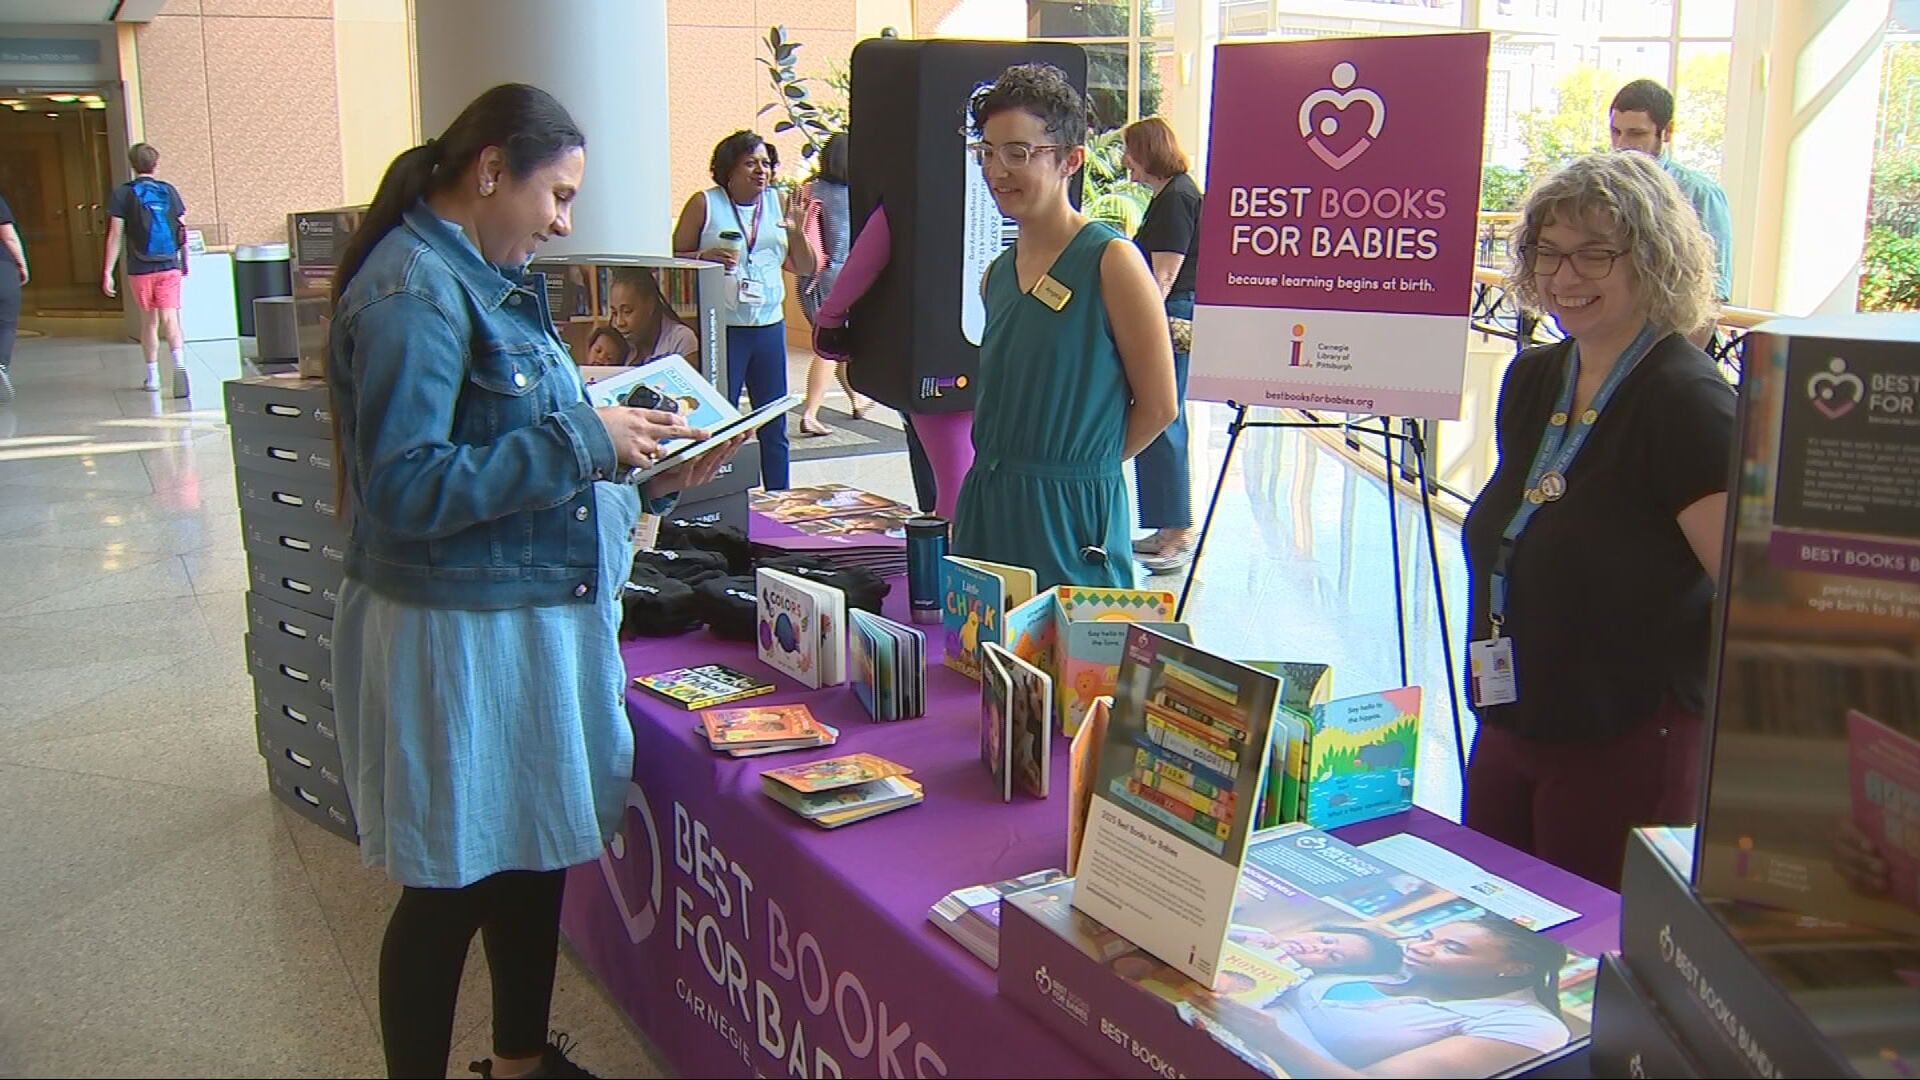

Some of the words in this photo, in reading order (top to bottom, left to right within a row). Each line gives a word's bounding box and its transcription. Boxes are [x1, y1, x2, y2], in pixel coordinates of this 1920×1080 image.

[1229, 188, 1312, 218] BEST
[1319, 188, 1447, 219] BOOKS
[1231, 225, 1301, 256] FOR
[1311, 227, 1438, 260] BABIES
[1228, 272, 1278, 287] because
[1281, 275, 1334, 292] learning
[1337, 276, 1379, 292] begins
[1382, 279, 1397, 291] at
[1399, 277, 1436, 293] birth.
[1317, 352, 1341, 362] Library
[1342, 353, 1351, 361] of
[1318, 343, 1349, 352] Carnegie
[1316, 362, 1353, 371] Pittsburgh
[1871, 374, 1920, 394] BEST
[1265, 390, 1375, 408] bestbooksforbabies.org
[1869, 394, 1913, 413] FOR
[1801, 546, 1840, 563] BEST
[1845, 551, 1906, 571] BOOKS
[962, 580, 980, 596] Little
[1822, 583, 1871, 598] perfect
[1875, 585, 1894, 600] for
[770, 591, 801, 618] COLORS
[946, 592, 996, 632] CHICK
[1808, 597, 1834, 613] age
[1837, 597, 1869, 613] birth
[1873, 600, 1887, 614] to
[1088, 630, 1100, 638] Say
[1348, 706, 1359, 714] Say
[1360, 703, 1375, 711] hello
[674, 800, 753, 941] BEST
[675, 886, 751, 1023] FOR
[1675, 947, 1699, 988] BEST
[1700, 976, 1738, 1038] BOOKS
[676, 977, 751, 1067] CARNEGIE
[1100, 1017, 1130, 1049] BEST
[1131, 1039, 1177, 1079] BOOKS
